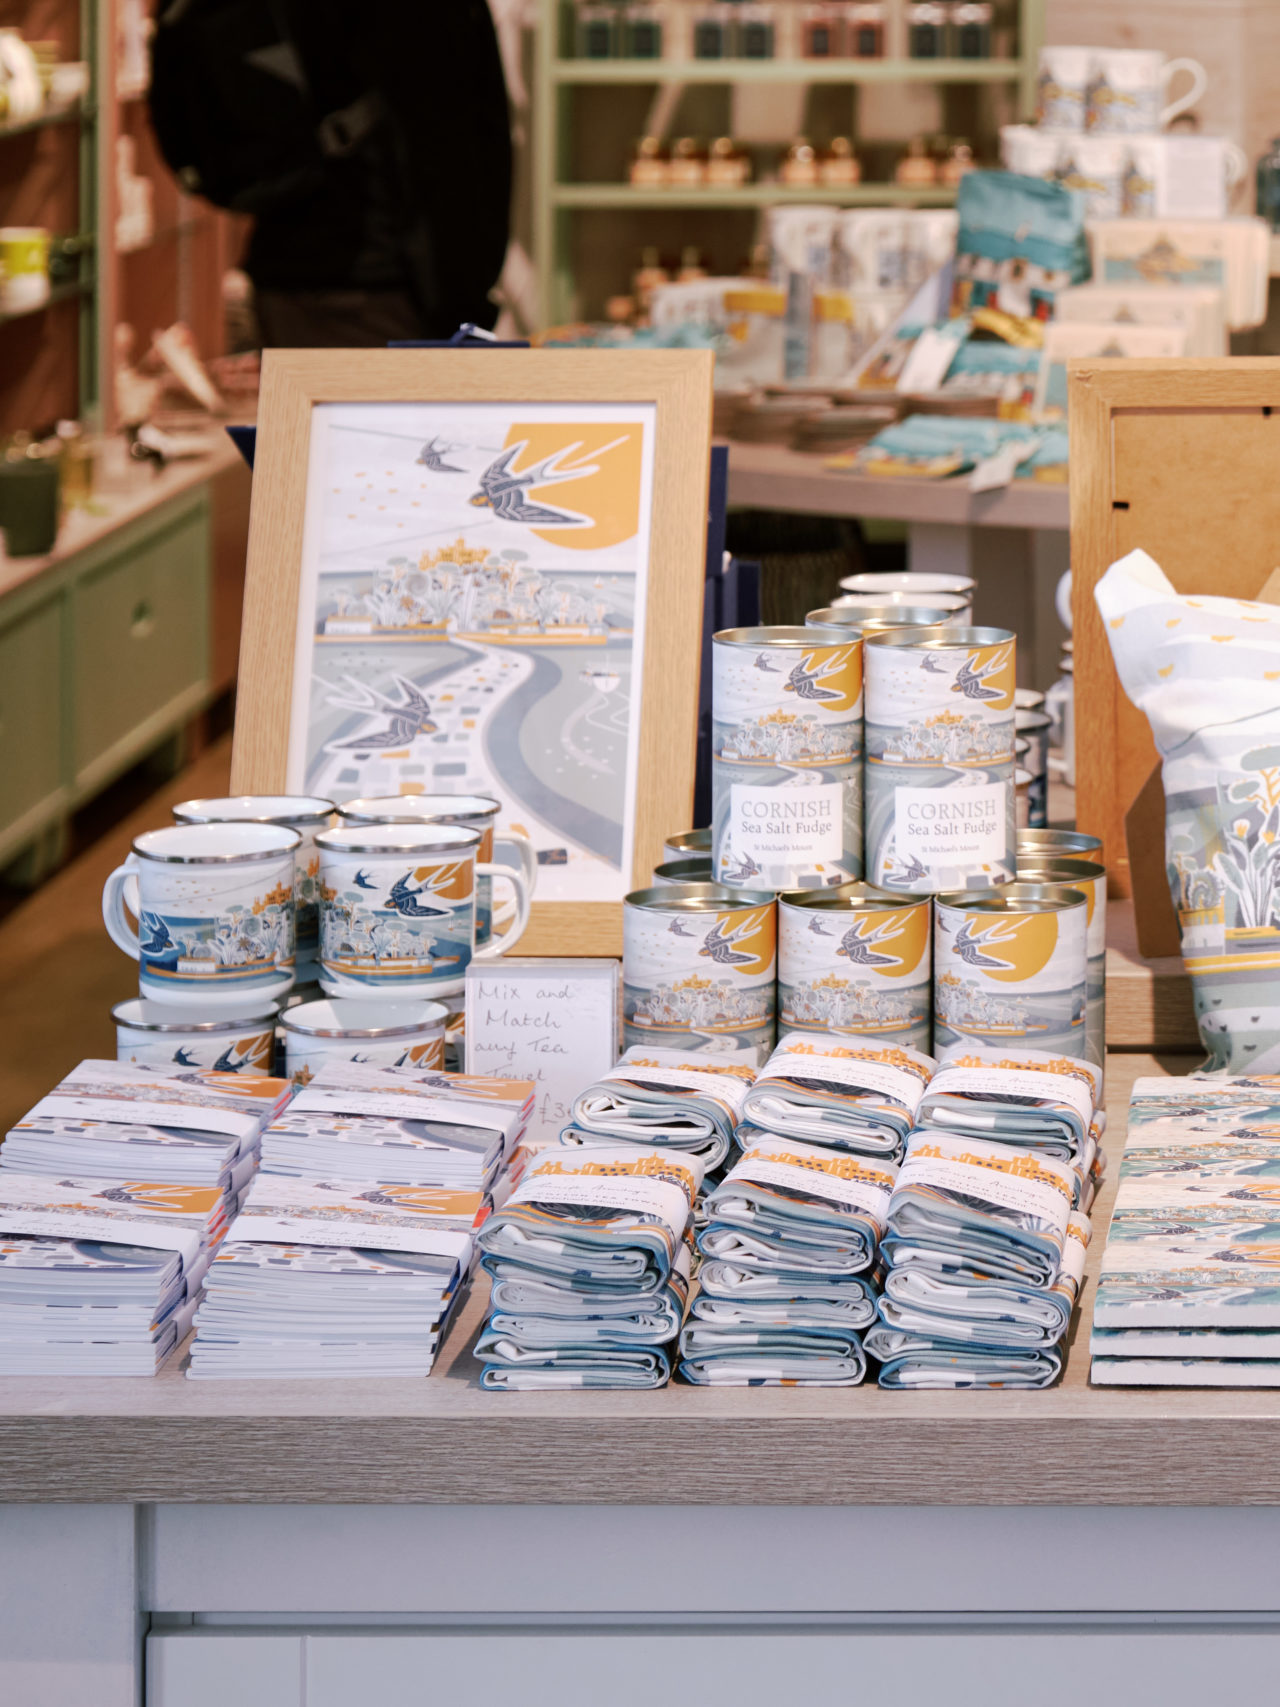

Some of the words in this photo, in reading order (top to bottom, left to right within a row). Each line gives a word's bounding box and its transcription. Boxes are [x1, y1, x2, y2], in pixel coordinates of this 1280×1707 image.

[741, 799, 832, 819] CORNISH
[907, 799, 997, 821] CORNISH
[742, 821, 762, 834] Sea
[766, 821, 791, 835] Salt
[796, 819, 832, 836] Fudge
[908, 822, 930, 836] Sea
[934, 822, 959, 837] Salt
[964, 819, 998, 836] Fudge
[478, 981, 521, 1000] Mix
[536, 984, 574, 999] and
[485, 1009, 562, 1030] Match
[474, 1041, 517, 1061] any
[527, 1036, 570, 1055] Tea
[538, 1092, 571, 1125] £3
